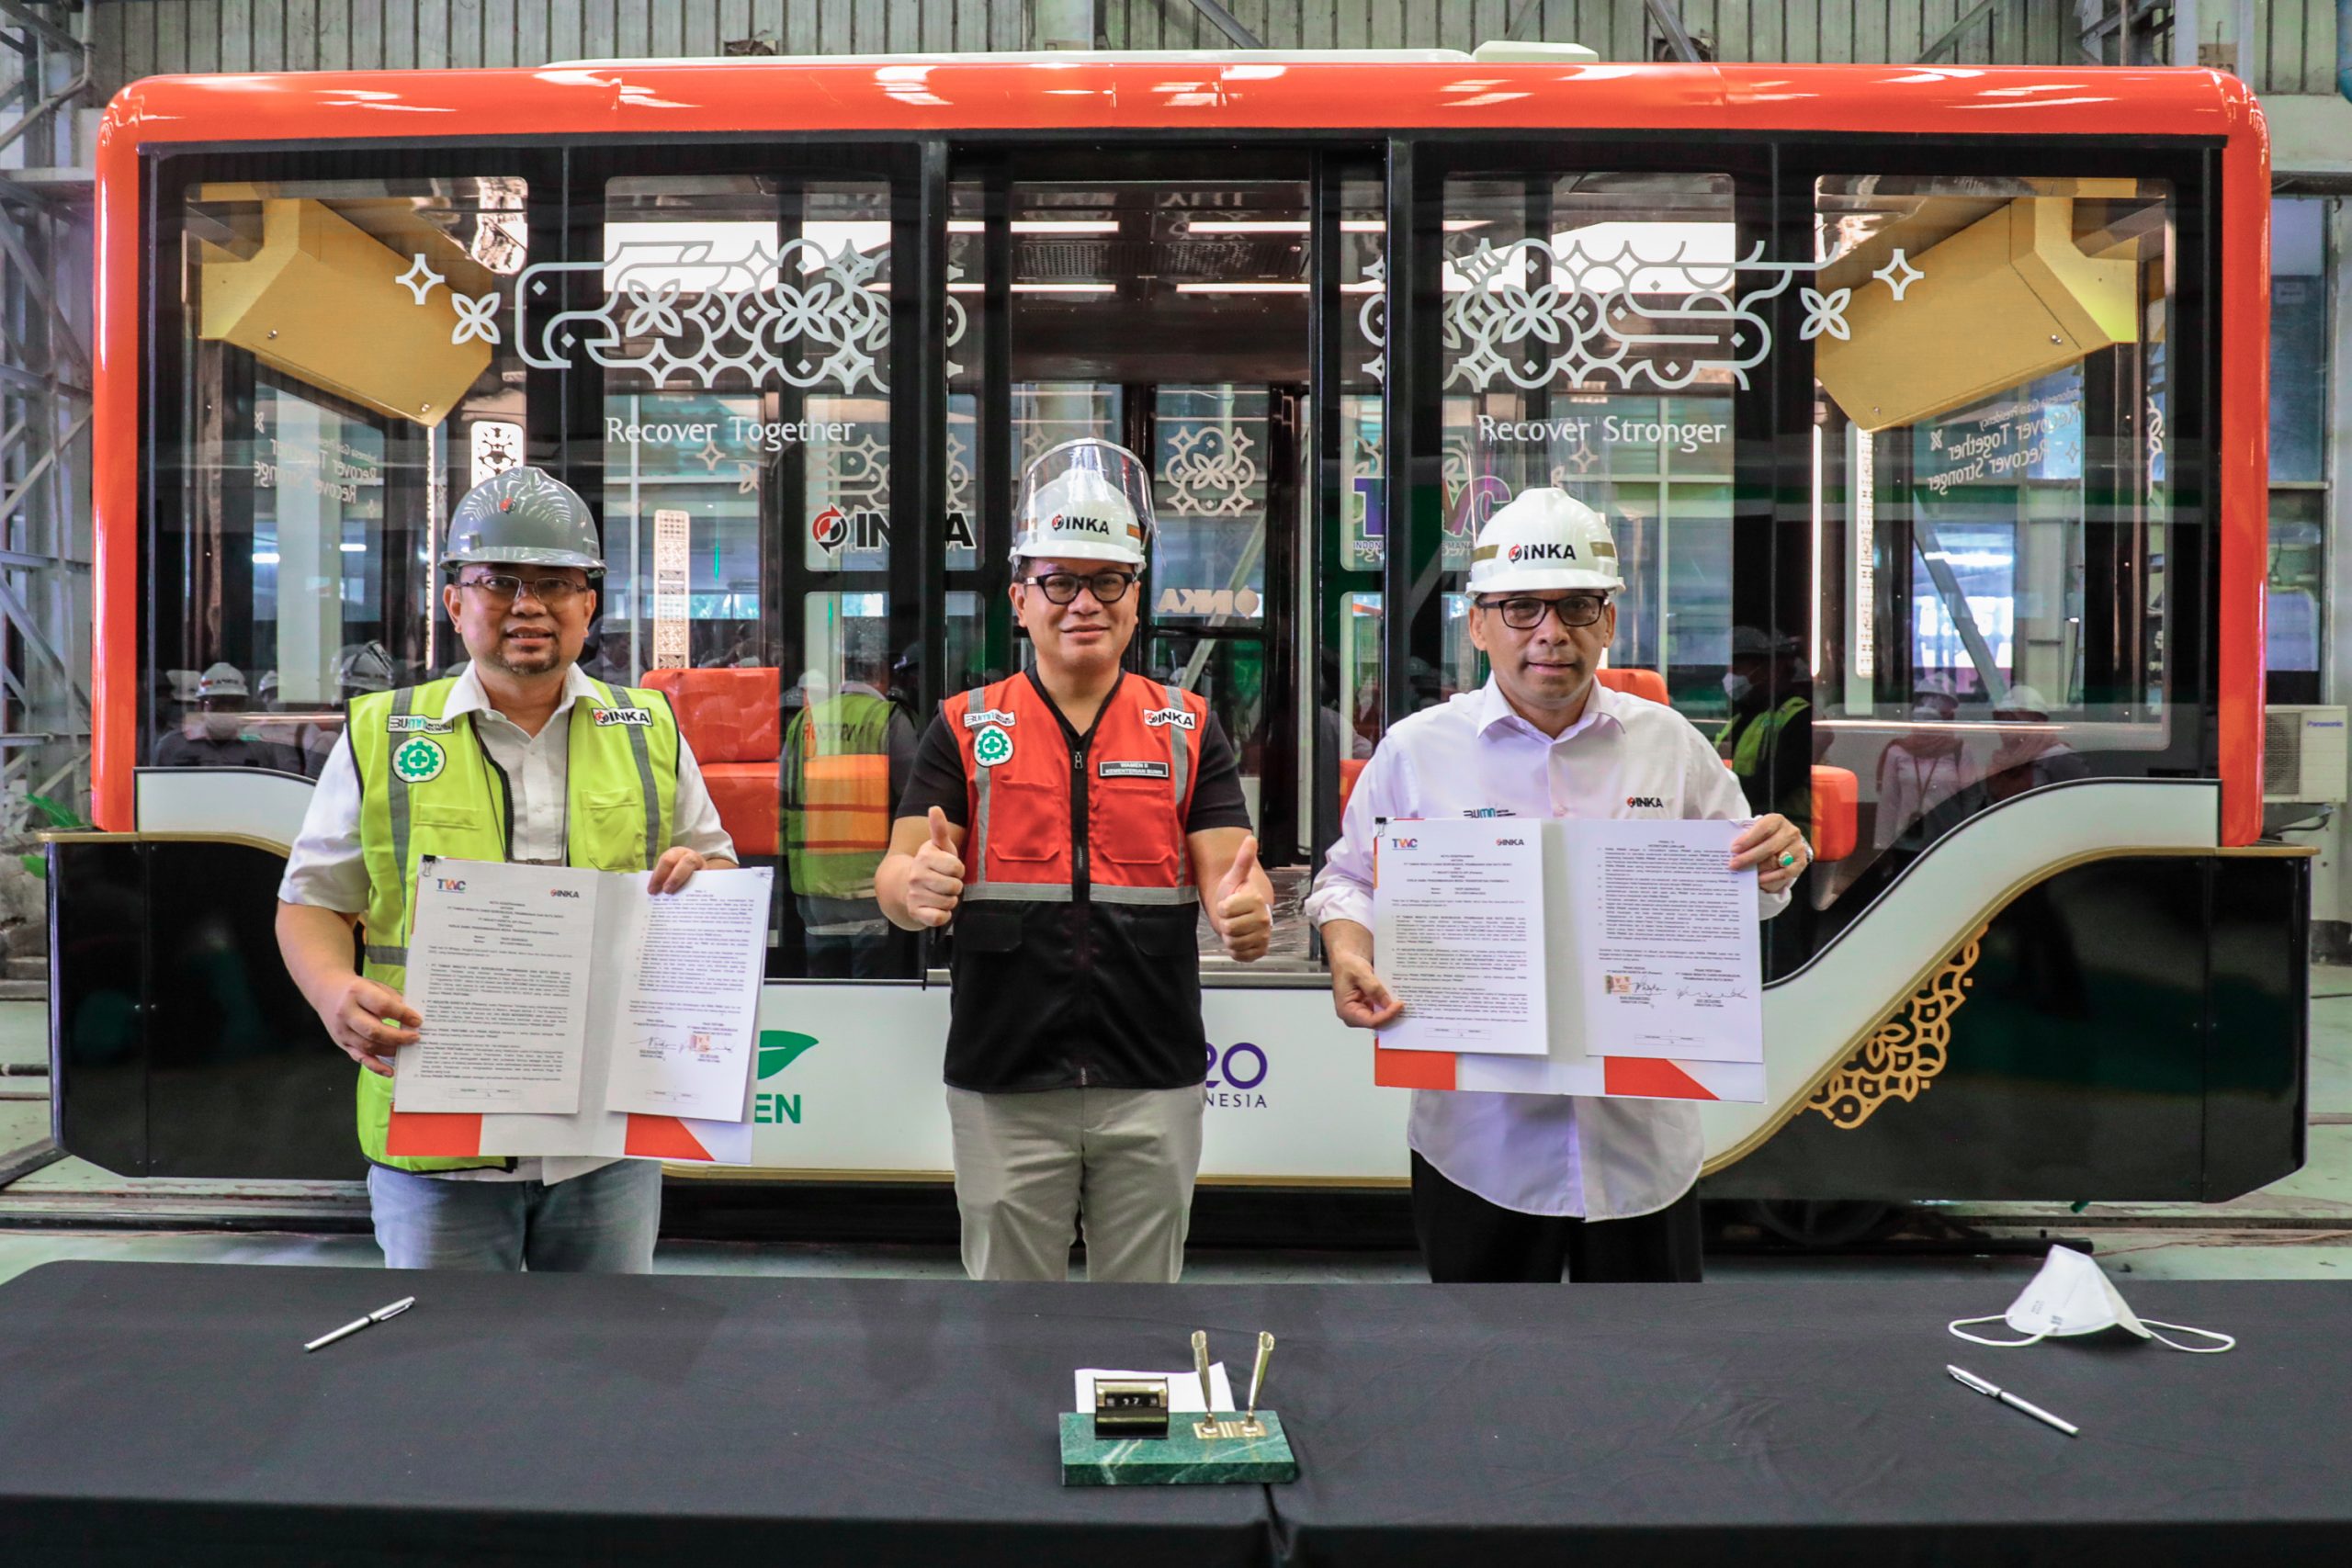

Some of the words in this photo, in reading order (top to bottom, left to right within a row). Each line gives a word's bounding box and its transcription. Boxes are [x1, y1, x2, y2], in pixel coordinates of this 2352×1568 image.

[605, 417, 718, 443] Recover
[729, 416, 855, 451] Together
[1476, 414, 1591, 441] Recover
[1602, 415, 1726, 452] Stronger
[854, 511, 978, 550] INA
[1066, 515, 1110, 536] INKA
[1523, 543, 1577, 560] INKA
[608, 711, 650, 724] INKA
[1158, 711, 1193, 726] INKA
[1635, 796, 1664, 808] INKA
